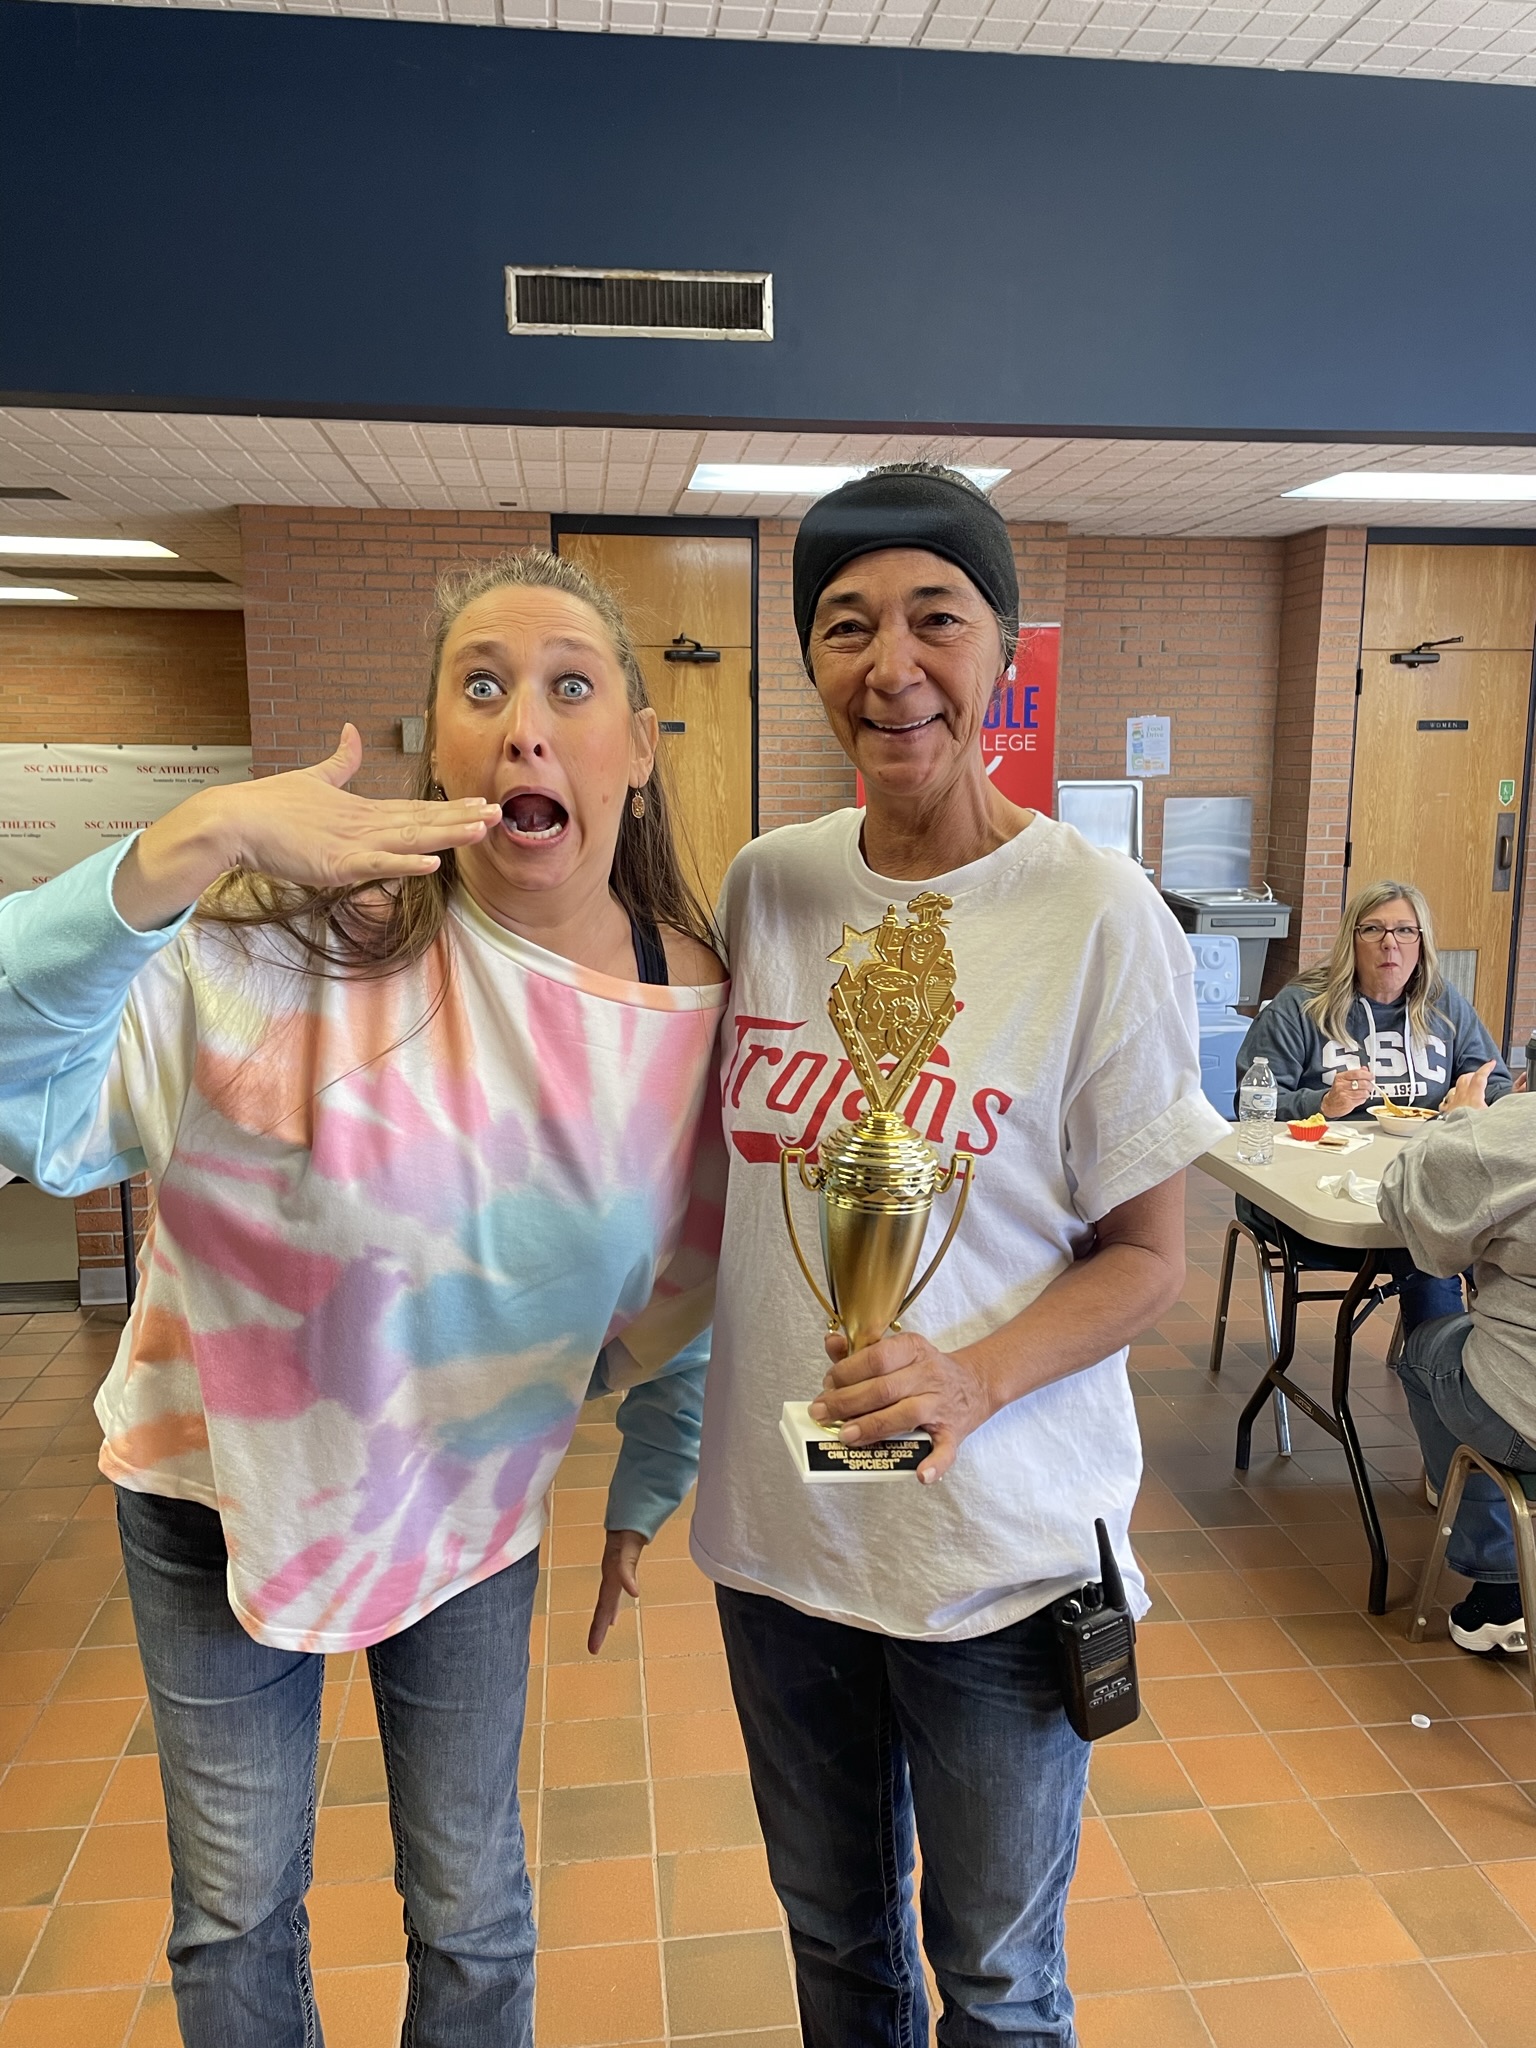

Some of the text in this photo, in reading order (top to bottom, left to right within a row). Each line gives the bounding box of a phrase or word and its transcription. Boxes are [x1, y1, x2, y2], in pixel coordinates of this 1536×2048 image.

[982, 734, 1037, 751] LEGE
[24, 765, 108, 773] SSC ATHLETICS
[136, 765, 220, 774] SSC ATHLETICS
[0, 821, 56, 829] THLETICS
[84, 821, 104, 829] SSC
[1322, 1030, 1447, 1084] SSC
[885, 1441, 920, 1450] COLLEGE
[827, 1449, 914, 1459] CHILI COOK OFF 2022
